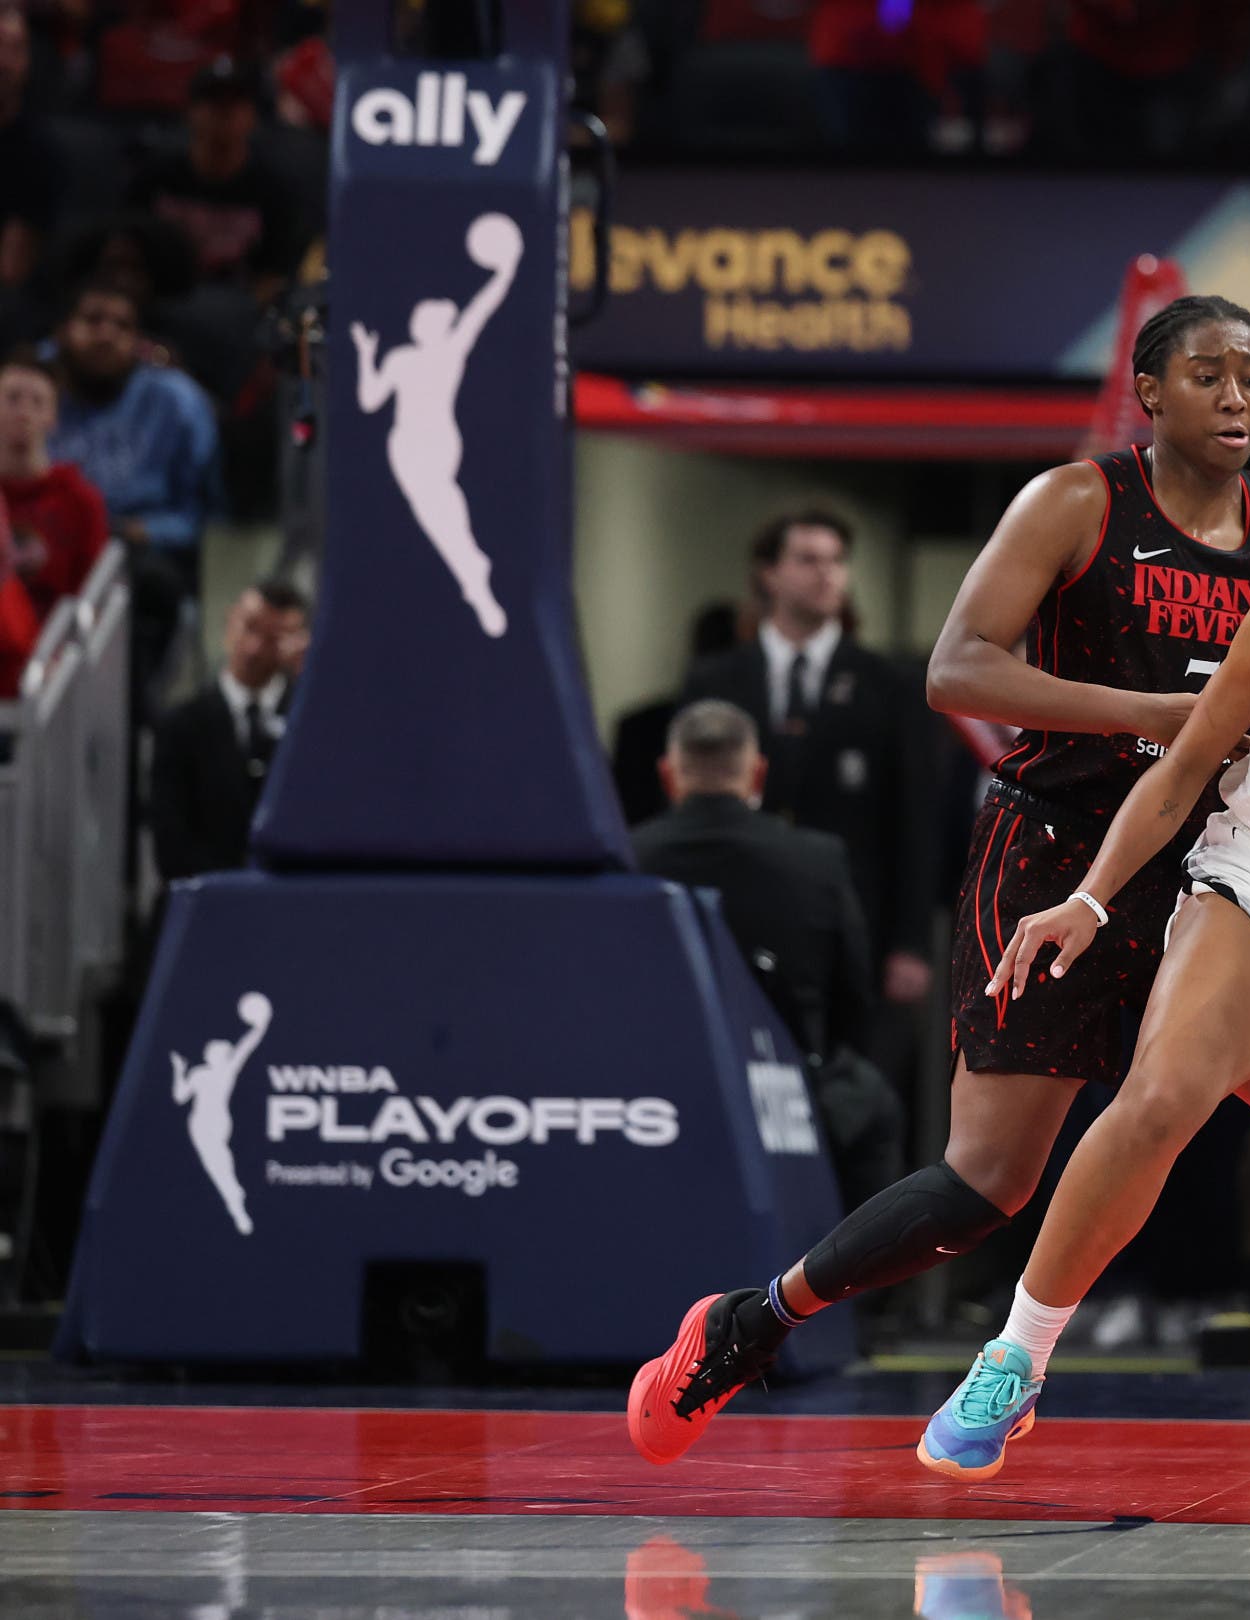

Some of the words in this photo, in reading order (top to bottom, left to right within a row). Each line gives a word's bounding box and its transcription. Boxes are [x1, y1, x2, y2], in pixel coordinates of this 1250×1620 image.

[352, 71, 527, 165] ally
[569, 208, 912, 296] levance
[705, 299, 912, 352] Health
[1146, 600, 1246, 646] FEVE
[266, 1064, 399, 1094] WNBA
[266, 1095, 681, 1147] PLAYOFFS
[266, 1159, 348, 1186] Presented
[352, 1161, 374, 1191] by
[379, 1147, 519, 1197] Google
